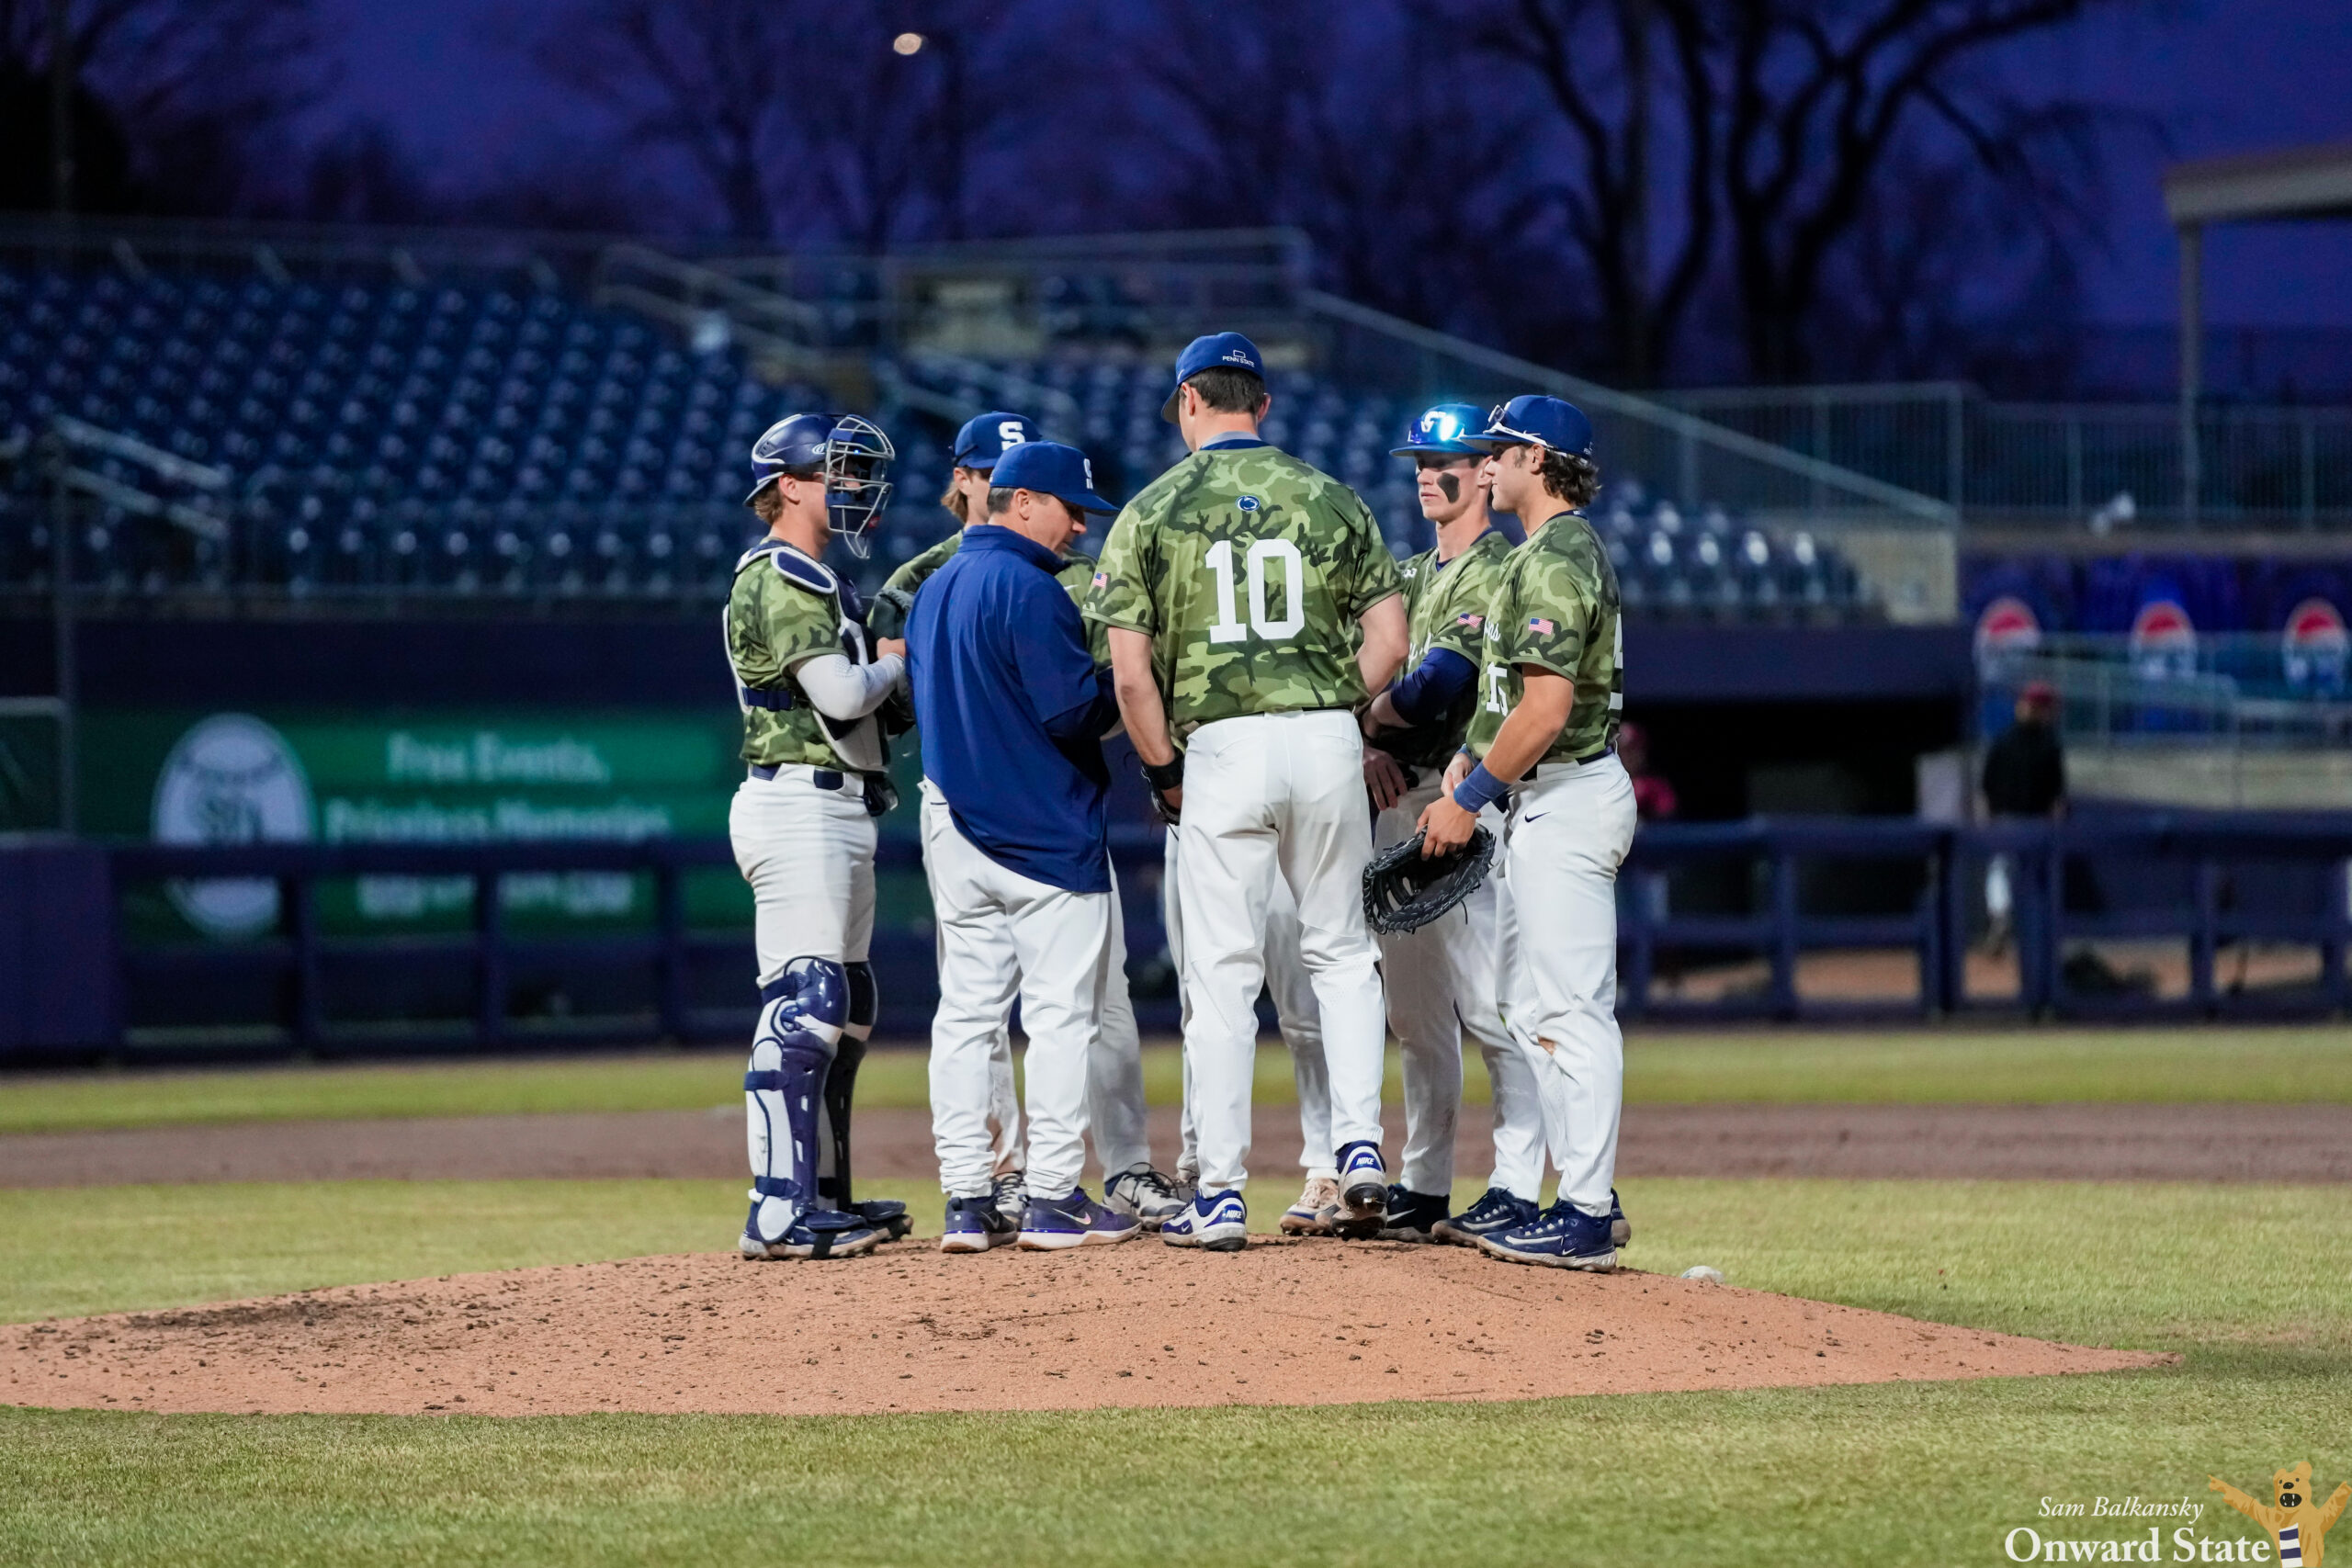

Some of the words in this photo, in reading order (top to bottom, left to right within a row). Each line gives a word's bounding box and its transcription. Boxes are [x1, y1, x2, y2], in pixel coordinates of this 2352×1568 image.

[1240, 358, 1255, 367] STATE
[999, 422, 1025, 451] S
[1205, 538, 1305, 644] 10
[1356, 1156, 1374, 1166] NIKE
[1226, 1209, 1242, 1219] NIKE
